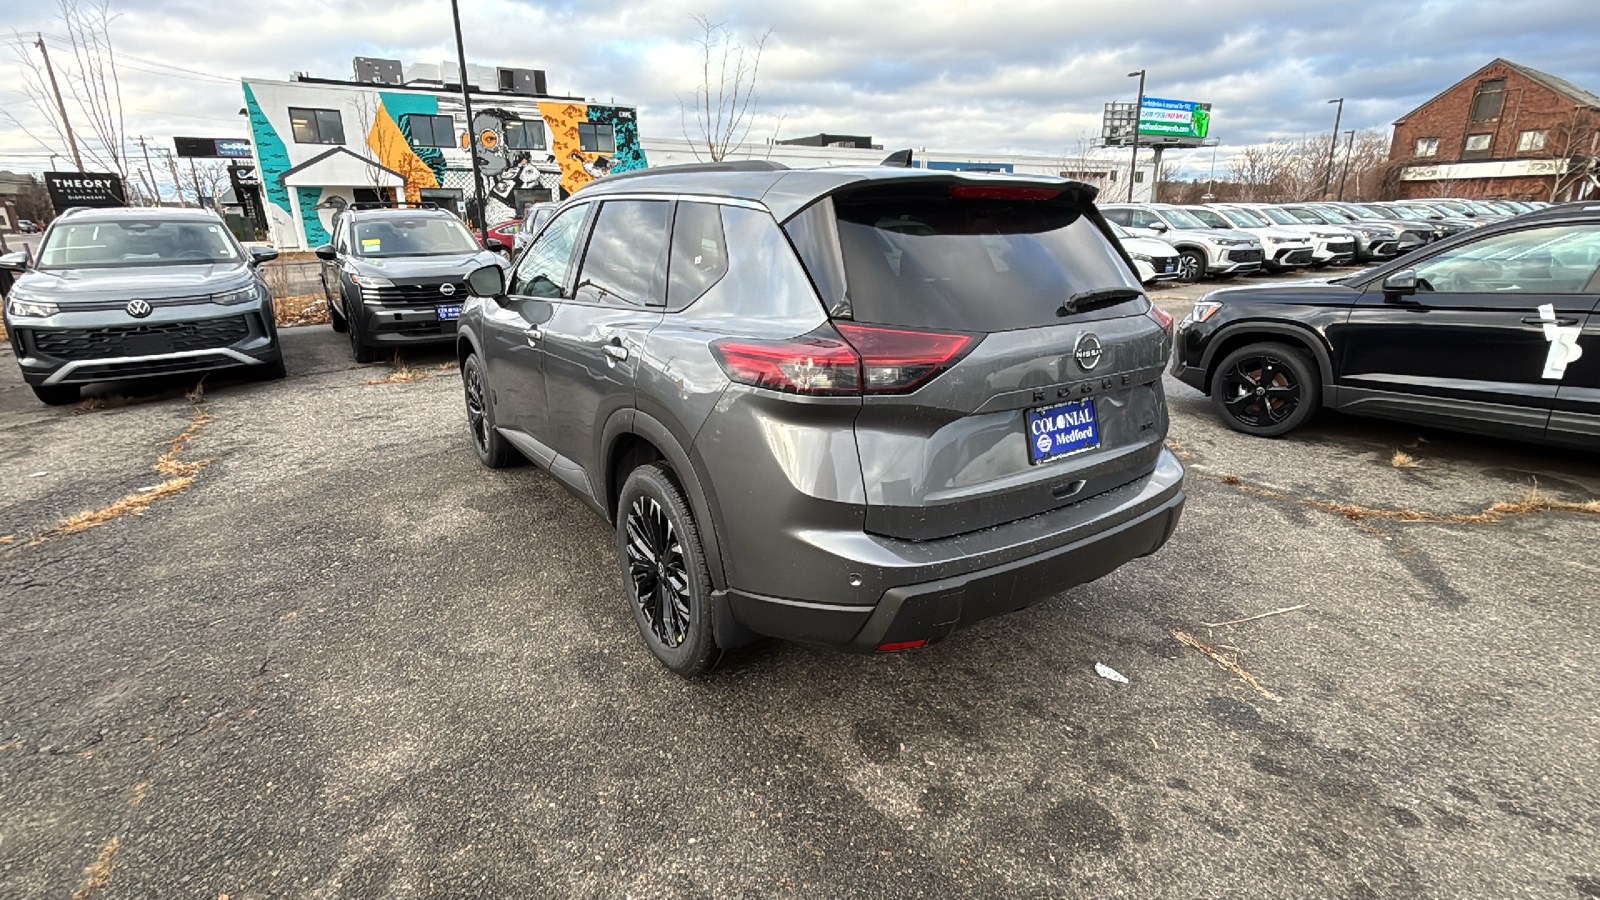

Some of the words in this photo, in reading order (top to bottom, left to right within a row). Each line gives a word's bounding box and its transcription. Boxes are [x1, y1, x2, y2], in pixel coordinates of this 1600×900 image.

[52, 179, 112, 188] THEORY
[1032, 376, 1131, 402] ROGUE
[1032, 408, 1093, 435] COLONIAL
[1055, 426, 1093, 446] Medford
